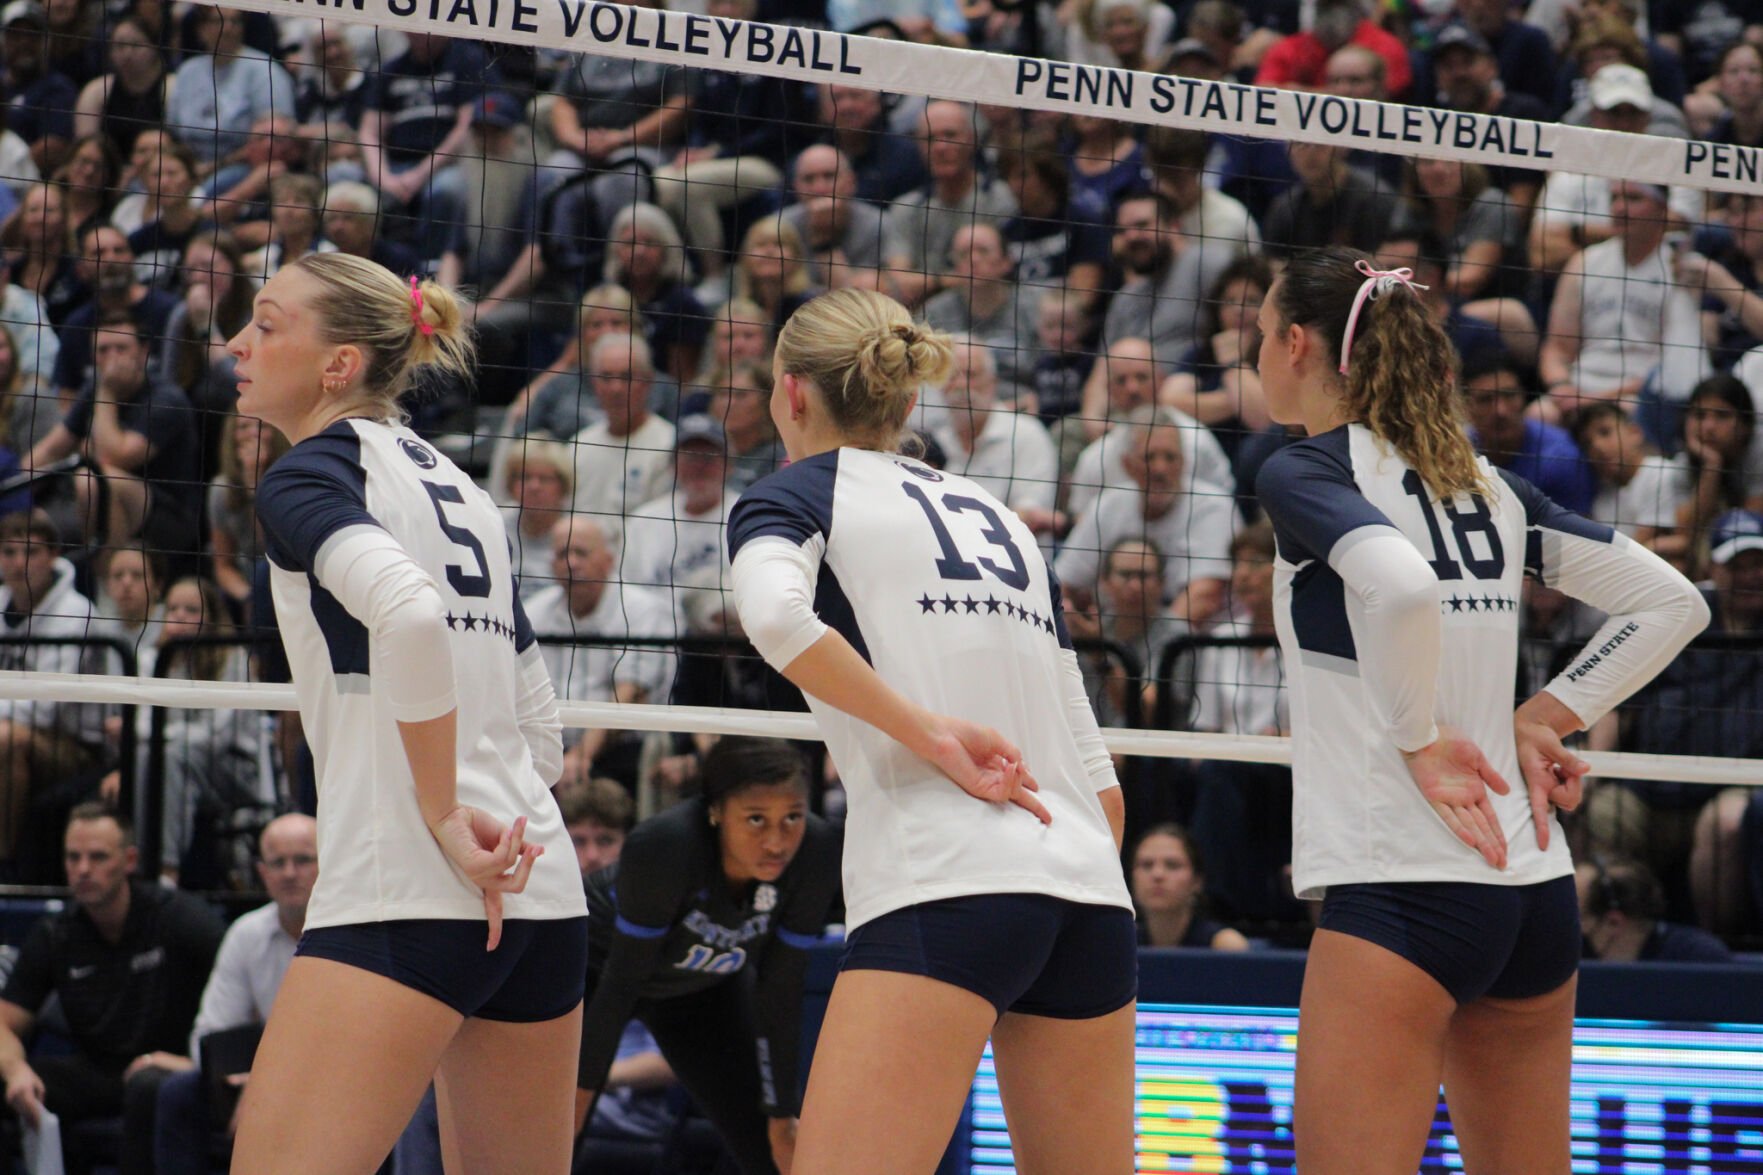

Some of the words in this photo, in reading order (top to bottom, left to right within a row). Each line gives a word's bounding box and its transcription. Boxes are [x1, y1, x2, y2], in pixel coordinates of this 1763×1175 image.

[558, 0, 862, 75] VOLLEYBALL
[1015, 58, 1133, 108] PENN
[1150, 76, 1278, 126] STATE
[1294, 93, 1554, 158] VOLLEYBALL
[1684, 141, 1763, 183] PEN
[420, 479, 492, 598] 5
[901, 481, 1030, 592] 13
[1402, 469, 1505, 580] 18
[1566, 654, 1602, 682] PENN
[1599, 622, 1639, 657] STATE
